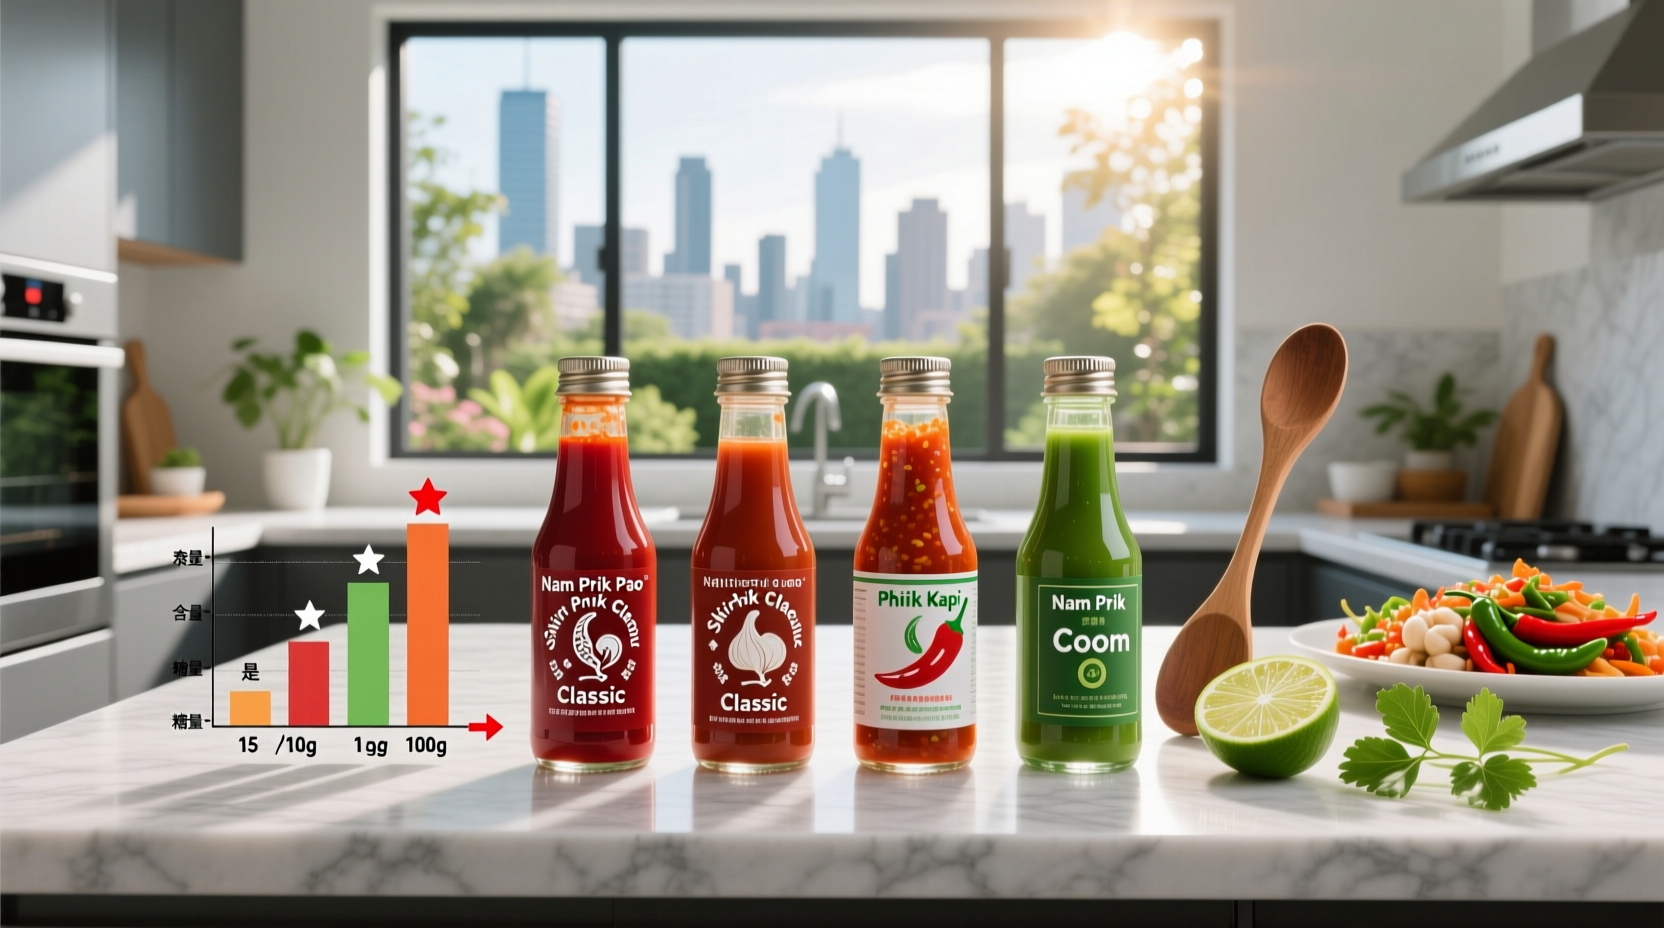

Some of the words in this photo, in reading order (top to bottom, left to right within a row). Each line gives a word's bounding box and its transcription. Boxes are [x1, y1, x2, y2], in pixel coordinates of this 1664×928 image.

[542, 576, 574, 592] Nam
[579, 576, 611, 592] Prik
[878, 590, 922, 607] Phiik
[927, 589, 961, 612] Kapi
[1052, 594, 1091, 611] Nam
[1095, 593, 1126, 611] Prik
[1053, 627, 1130, 653] Coom
[557, 685, 626, 704] Classic
[720, 692, 787, 712] Classic
